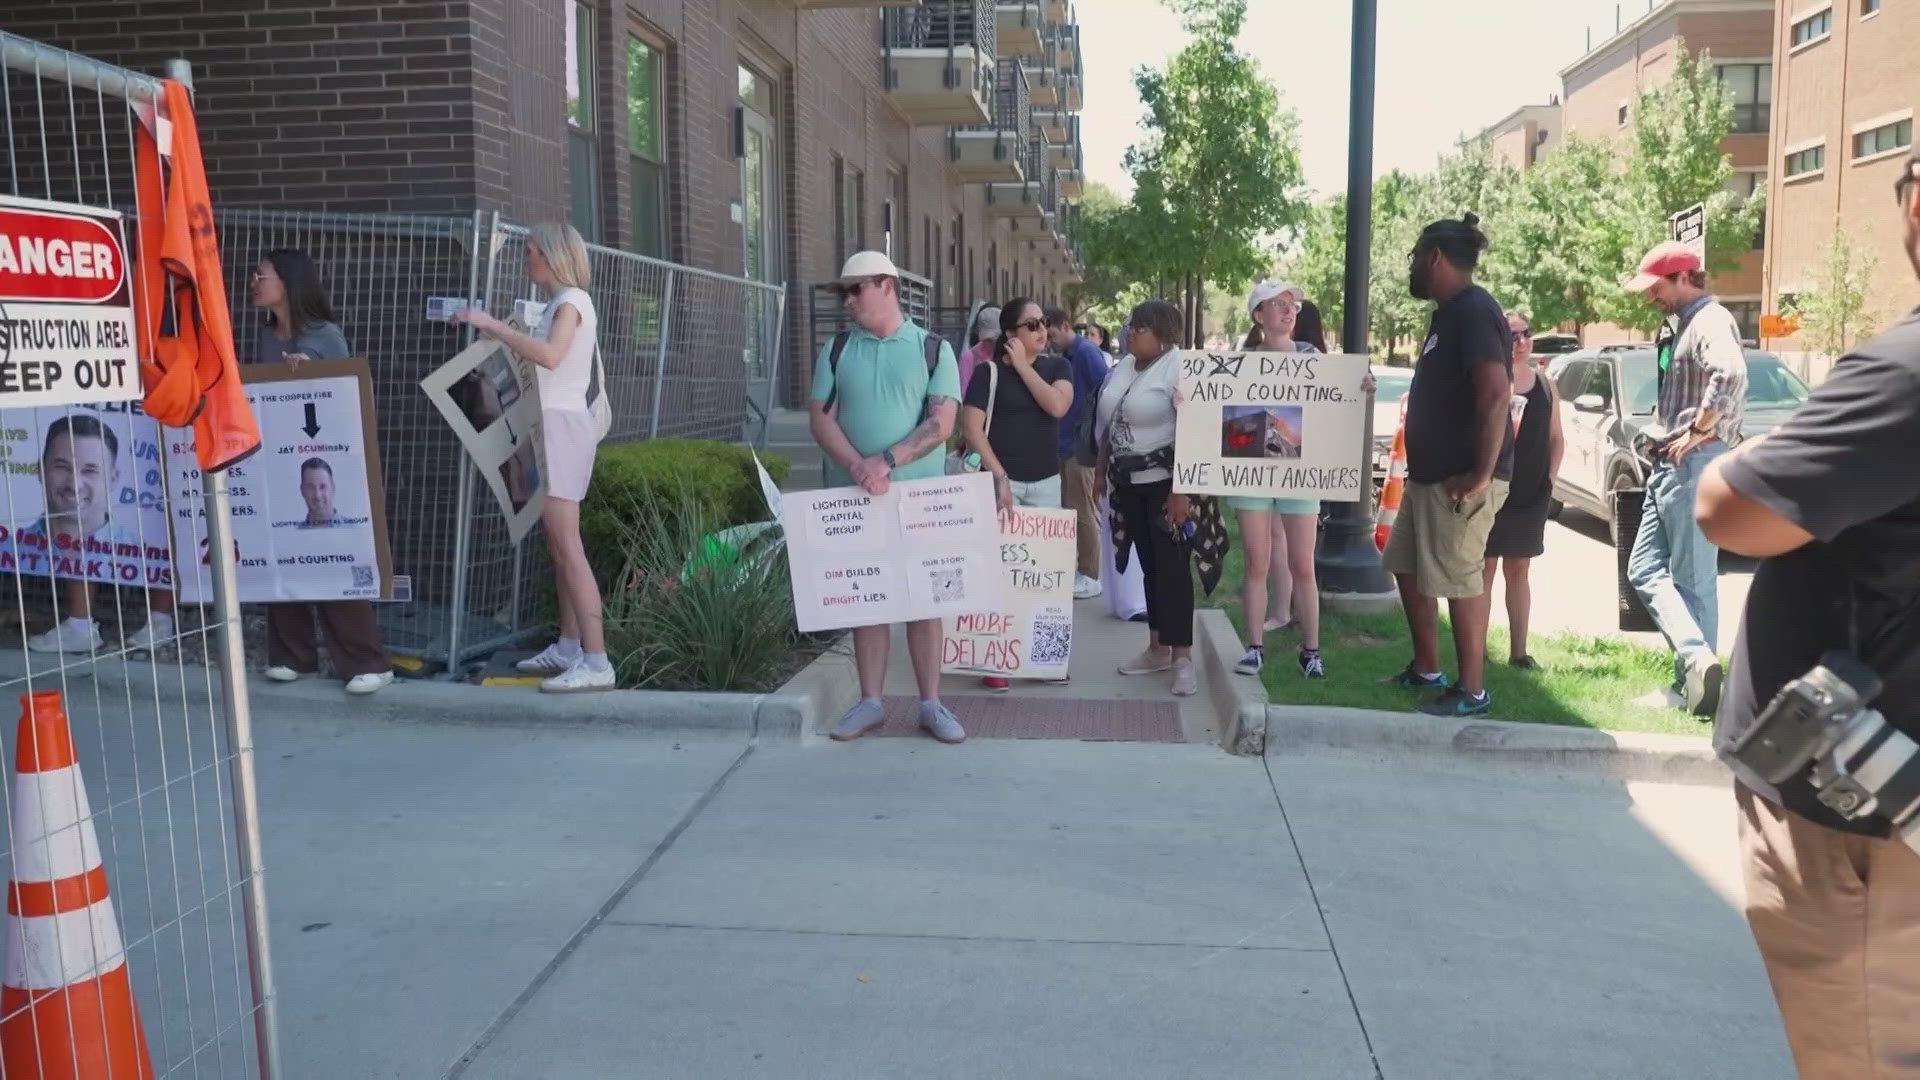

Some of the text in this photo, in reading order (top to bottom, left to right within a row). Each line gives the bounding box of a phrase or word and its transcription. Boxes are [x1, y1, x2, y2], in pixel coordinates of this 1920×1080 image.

[97, 321, 129, 349] AREA
[75, 360, 126, 390] OUT
[1183, 359, 1205, 379] 30
[1260, 357, 1318, 380] DAYS
[1190, 381, 1357, 403] AND COUNTING...
[278, 446, 294, 454] JAY
[1177, 463, 1359, 490] WE WANT ANSWERS
[812, 497, 871, 511] LIGHTBULB
[821, 511, 864, 523] CAPITAL
[47, 553, 102, 578] TALK
[109, 562, 138, 581] TO
[241, 559, 267, 567] DAYS
[298, 554, 355, 565] COUNTING
[825, 567, 880, 580] DIM BULBS
[1010, 569, 1065, 590] TRUST
[823, 595, 861, 606] BRIGHT
[956, 613, 1015, 633] MORE
[943, 637, 1021, 670] DELAYS
